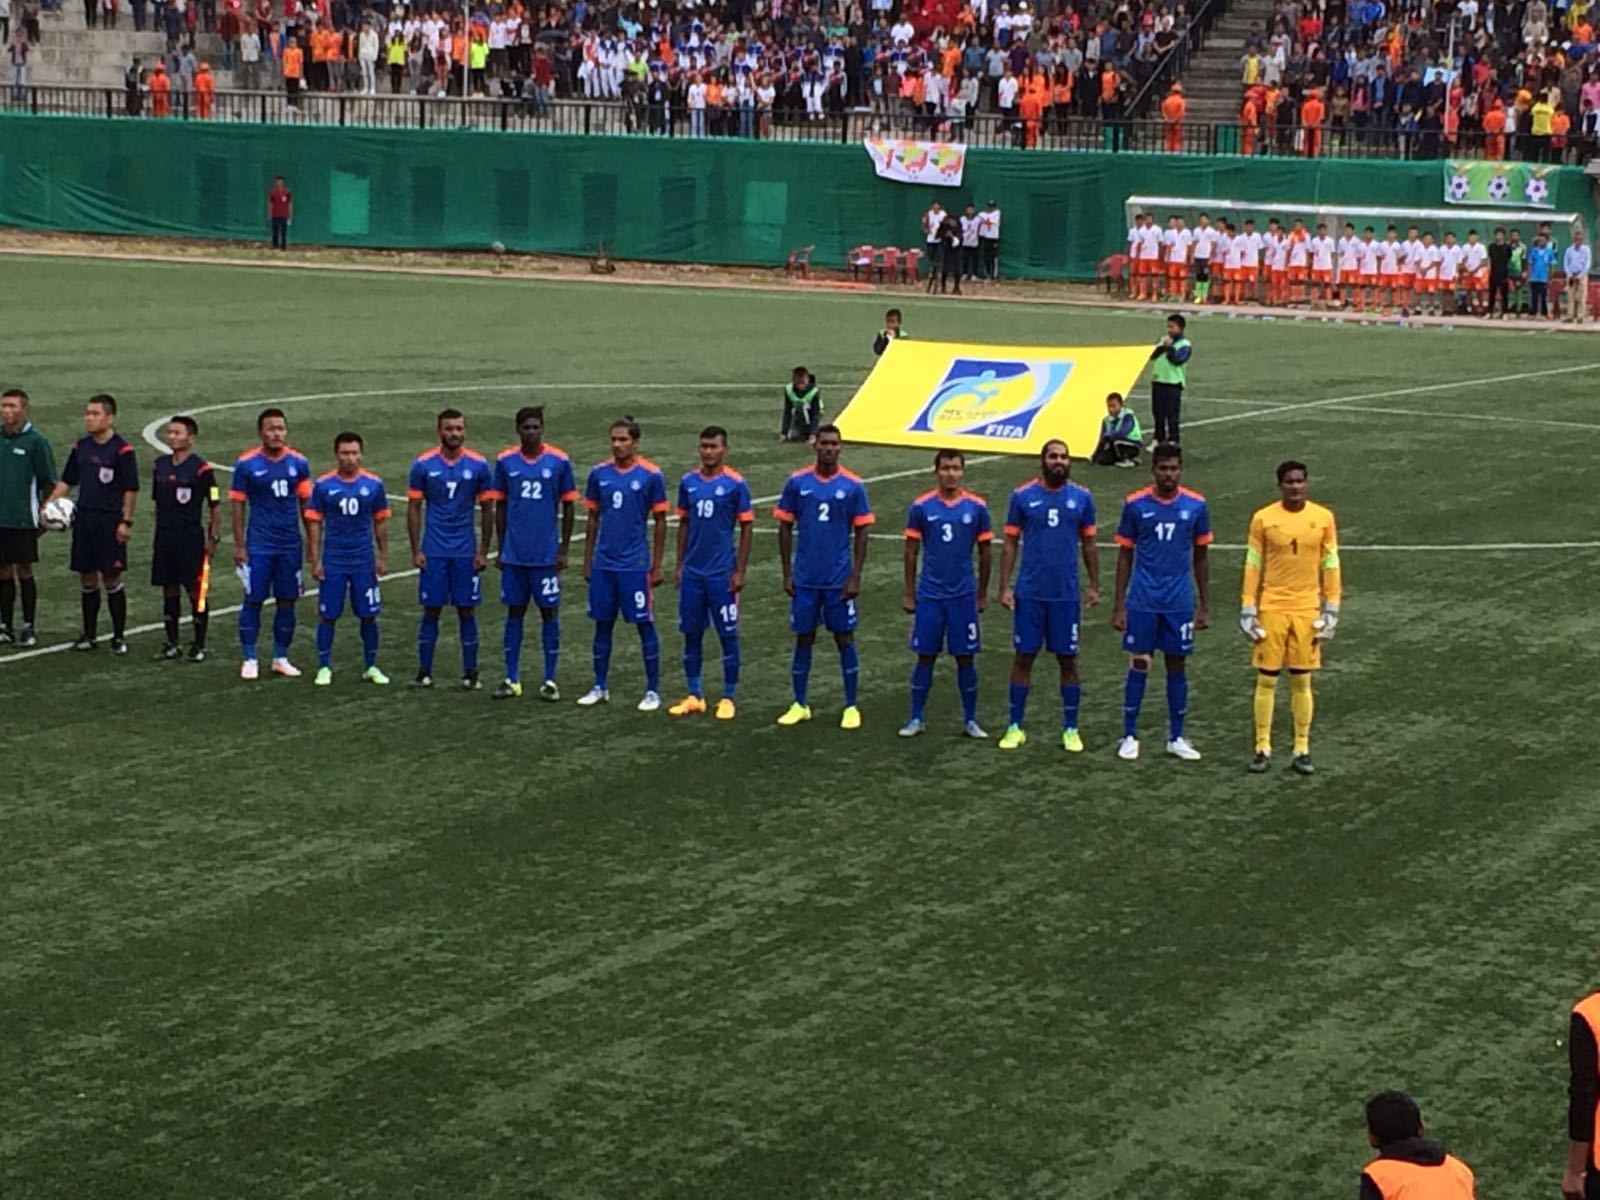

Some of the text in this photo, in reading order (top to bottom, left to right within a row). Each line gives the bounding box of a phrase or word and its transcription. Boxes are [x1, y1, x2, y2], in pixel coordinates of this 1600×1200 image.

[984, 424, 1024, 437] FIFA
[446, 482, 457, 499] 7
[521, 481, 542, 499] 22
[339, 498, 359, 515] 10
[612, 491, 623, 509] 9
[696, 499, 714, 518] 19
[818, 503, 830, 521] 2
[1047, 508, 1059, 527] 5
[942, 523, 953, 542] 3
[1155, 522, 1176, 541] 17
[1290, 538, 1298, 555] 1
[472, 576, 479, 593] 7
[541, 577, 560, 595] 22
[365, 587, 381, 605] 10
[634, 591, 645, 609] 9
[720, 604, 737, 622] 19
[967, 623, 977, 640] 3
